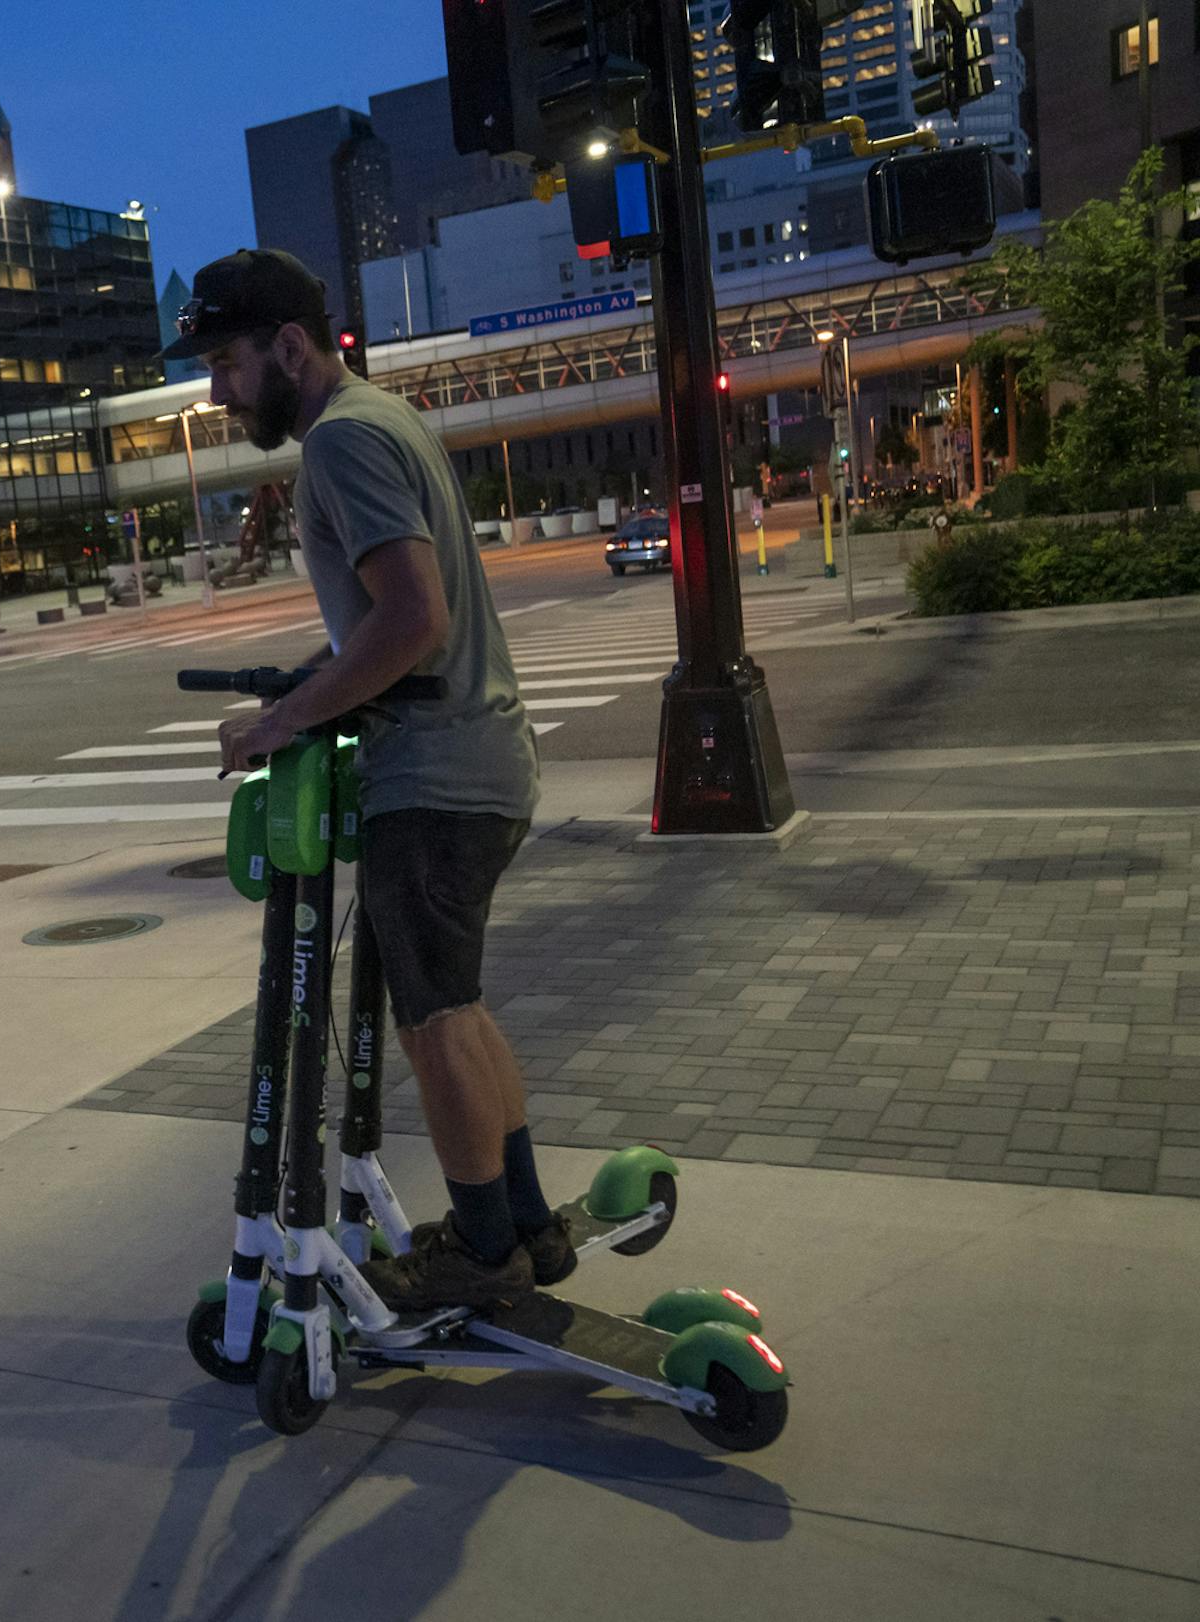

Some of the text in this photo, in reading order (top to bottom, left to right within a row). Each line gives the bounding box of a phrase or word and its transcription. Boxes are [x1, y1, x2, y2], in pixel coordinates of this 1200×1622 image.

[500, 296, 629, 329] S Washington Av
